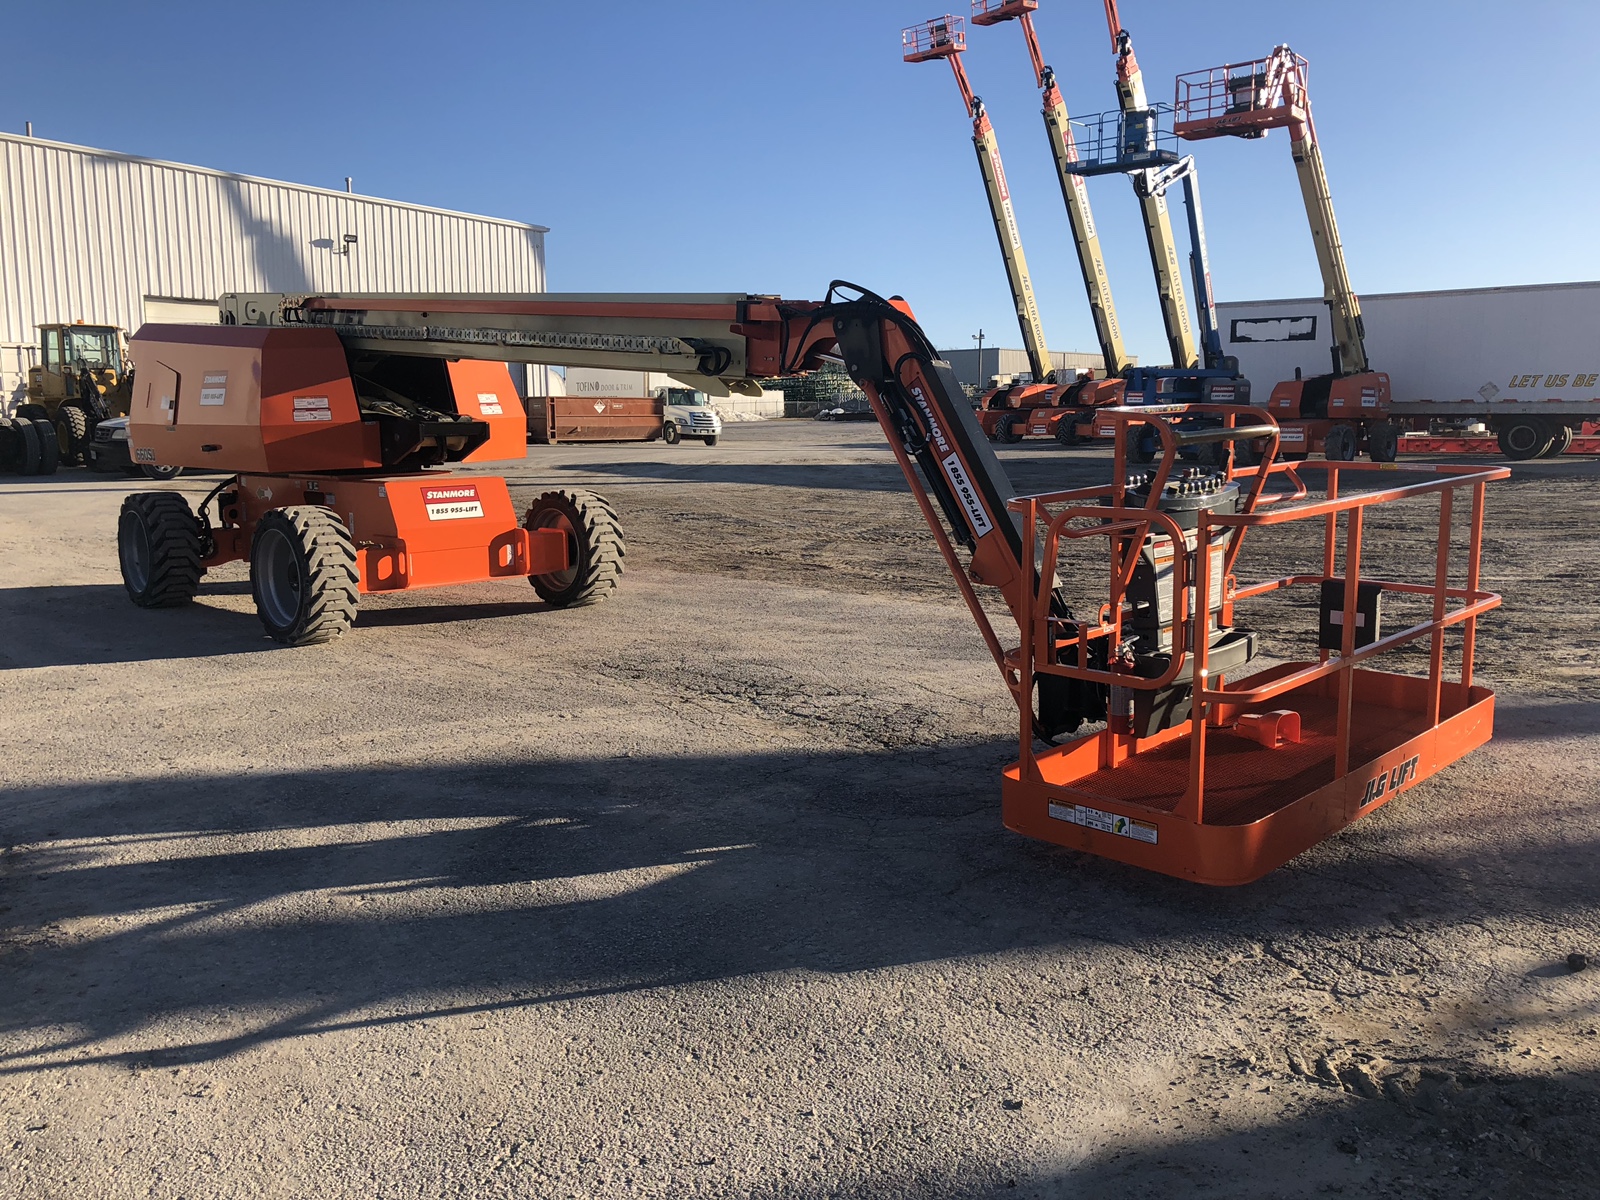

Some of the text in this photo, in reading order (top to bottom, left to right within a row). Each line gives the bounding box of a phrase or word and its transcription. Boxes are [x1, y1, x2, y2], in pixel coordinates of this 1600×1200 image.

[991, 150, 1008, 197] STANMORE
[1022, 274, 1045, 349] JLG ULTRA BOOM
[1095, 257, 1119, 340] JLG ULTRA BOOM
[1167, 244, 1189, 334] JLG ULTRA BOOM
[576, 381, 600, 392] TOFINO
[600, 384, 615, 392] DOOR
[1508, 373, 1600, 388] LET US BE
[136, 448, 155, 462] 660SJ
[911, 387, 950, 453] STANMORE
[951, 466, 965, 486] 855
[960, 486, 987, 529] 955-LIFT
[426, 489, 475, 500] STANMORE
[435, 507, 449, 515] 855
[1359, 753, 1420, 809] JLG LIFT
